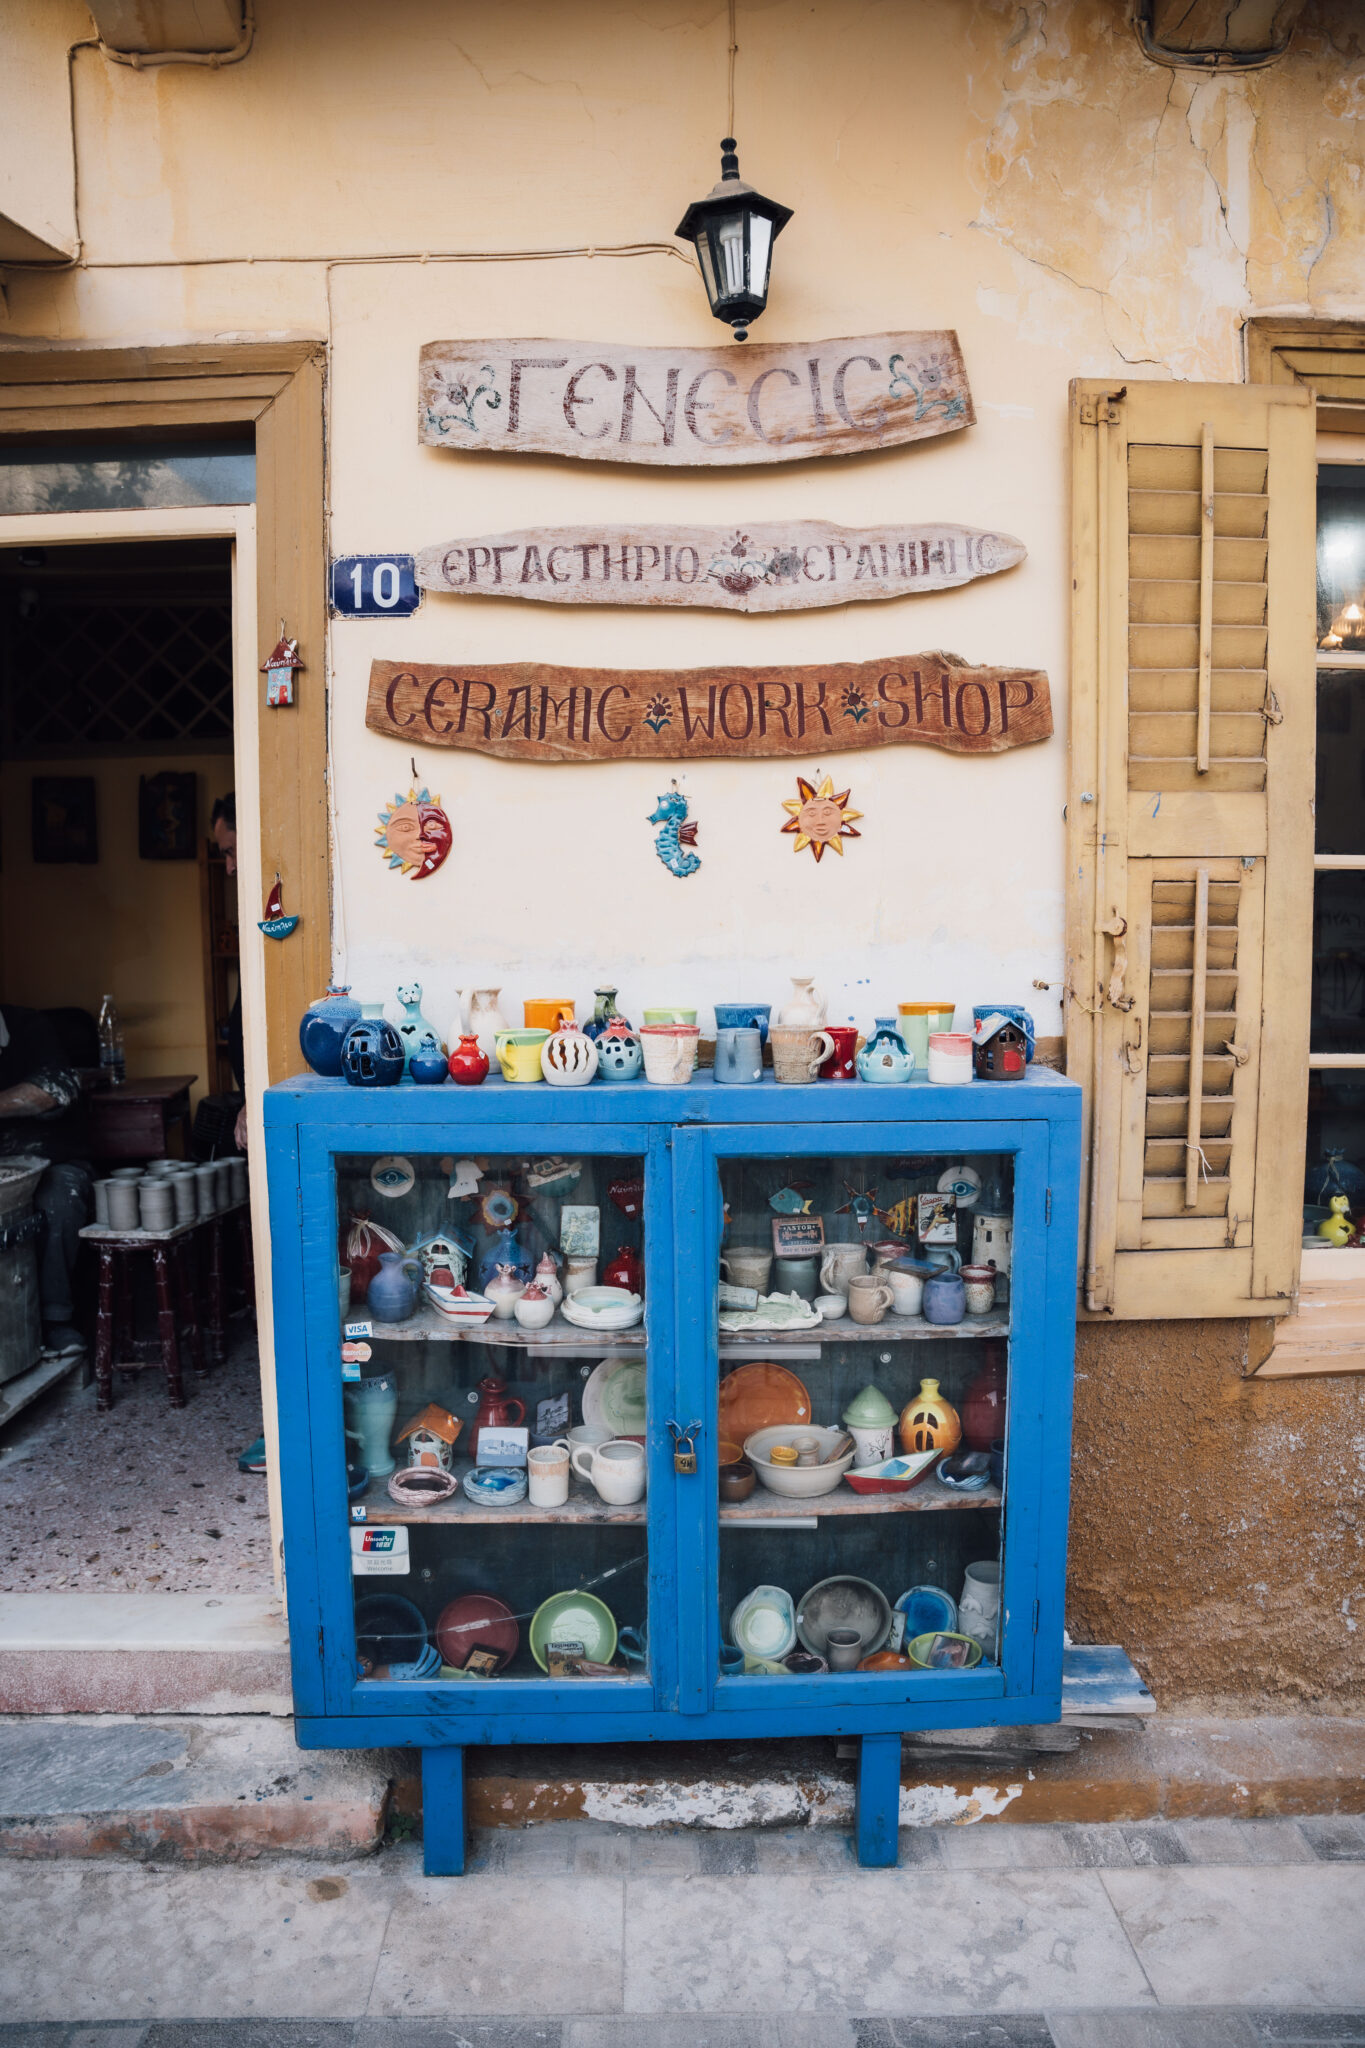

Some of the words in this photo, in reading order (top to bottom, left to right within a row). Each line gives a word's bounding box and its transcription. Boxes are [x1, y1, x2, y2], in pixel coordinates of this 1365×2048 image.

[350, 562, 401, 608] 10
[385, 672, 634, 743] CERAMIC
[677, 680, 833, 742] WORK
[877, 670, 1034, 737] SHOP
[348, 1325, 368, 1333] VISA
[365, 1535, 393, 1543] UnionPay
